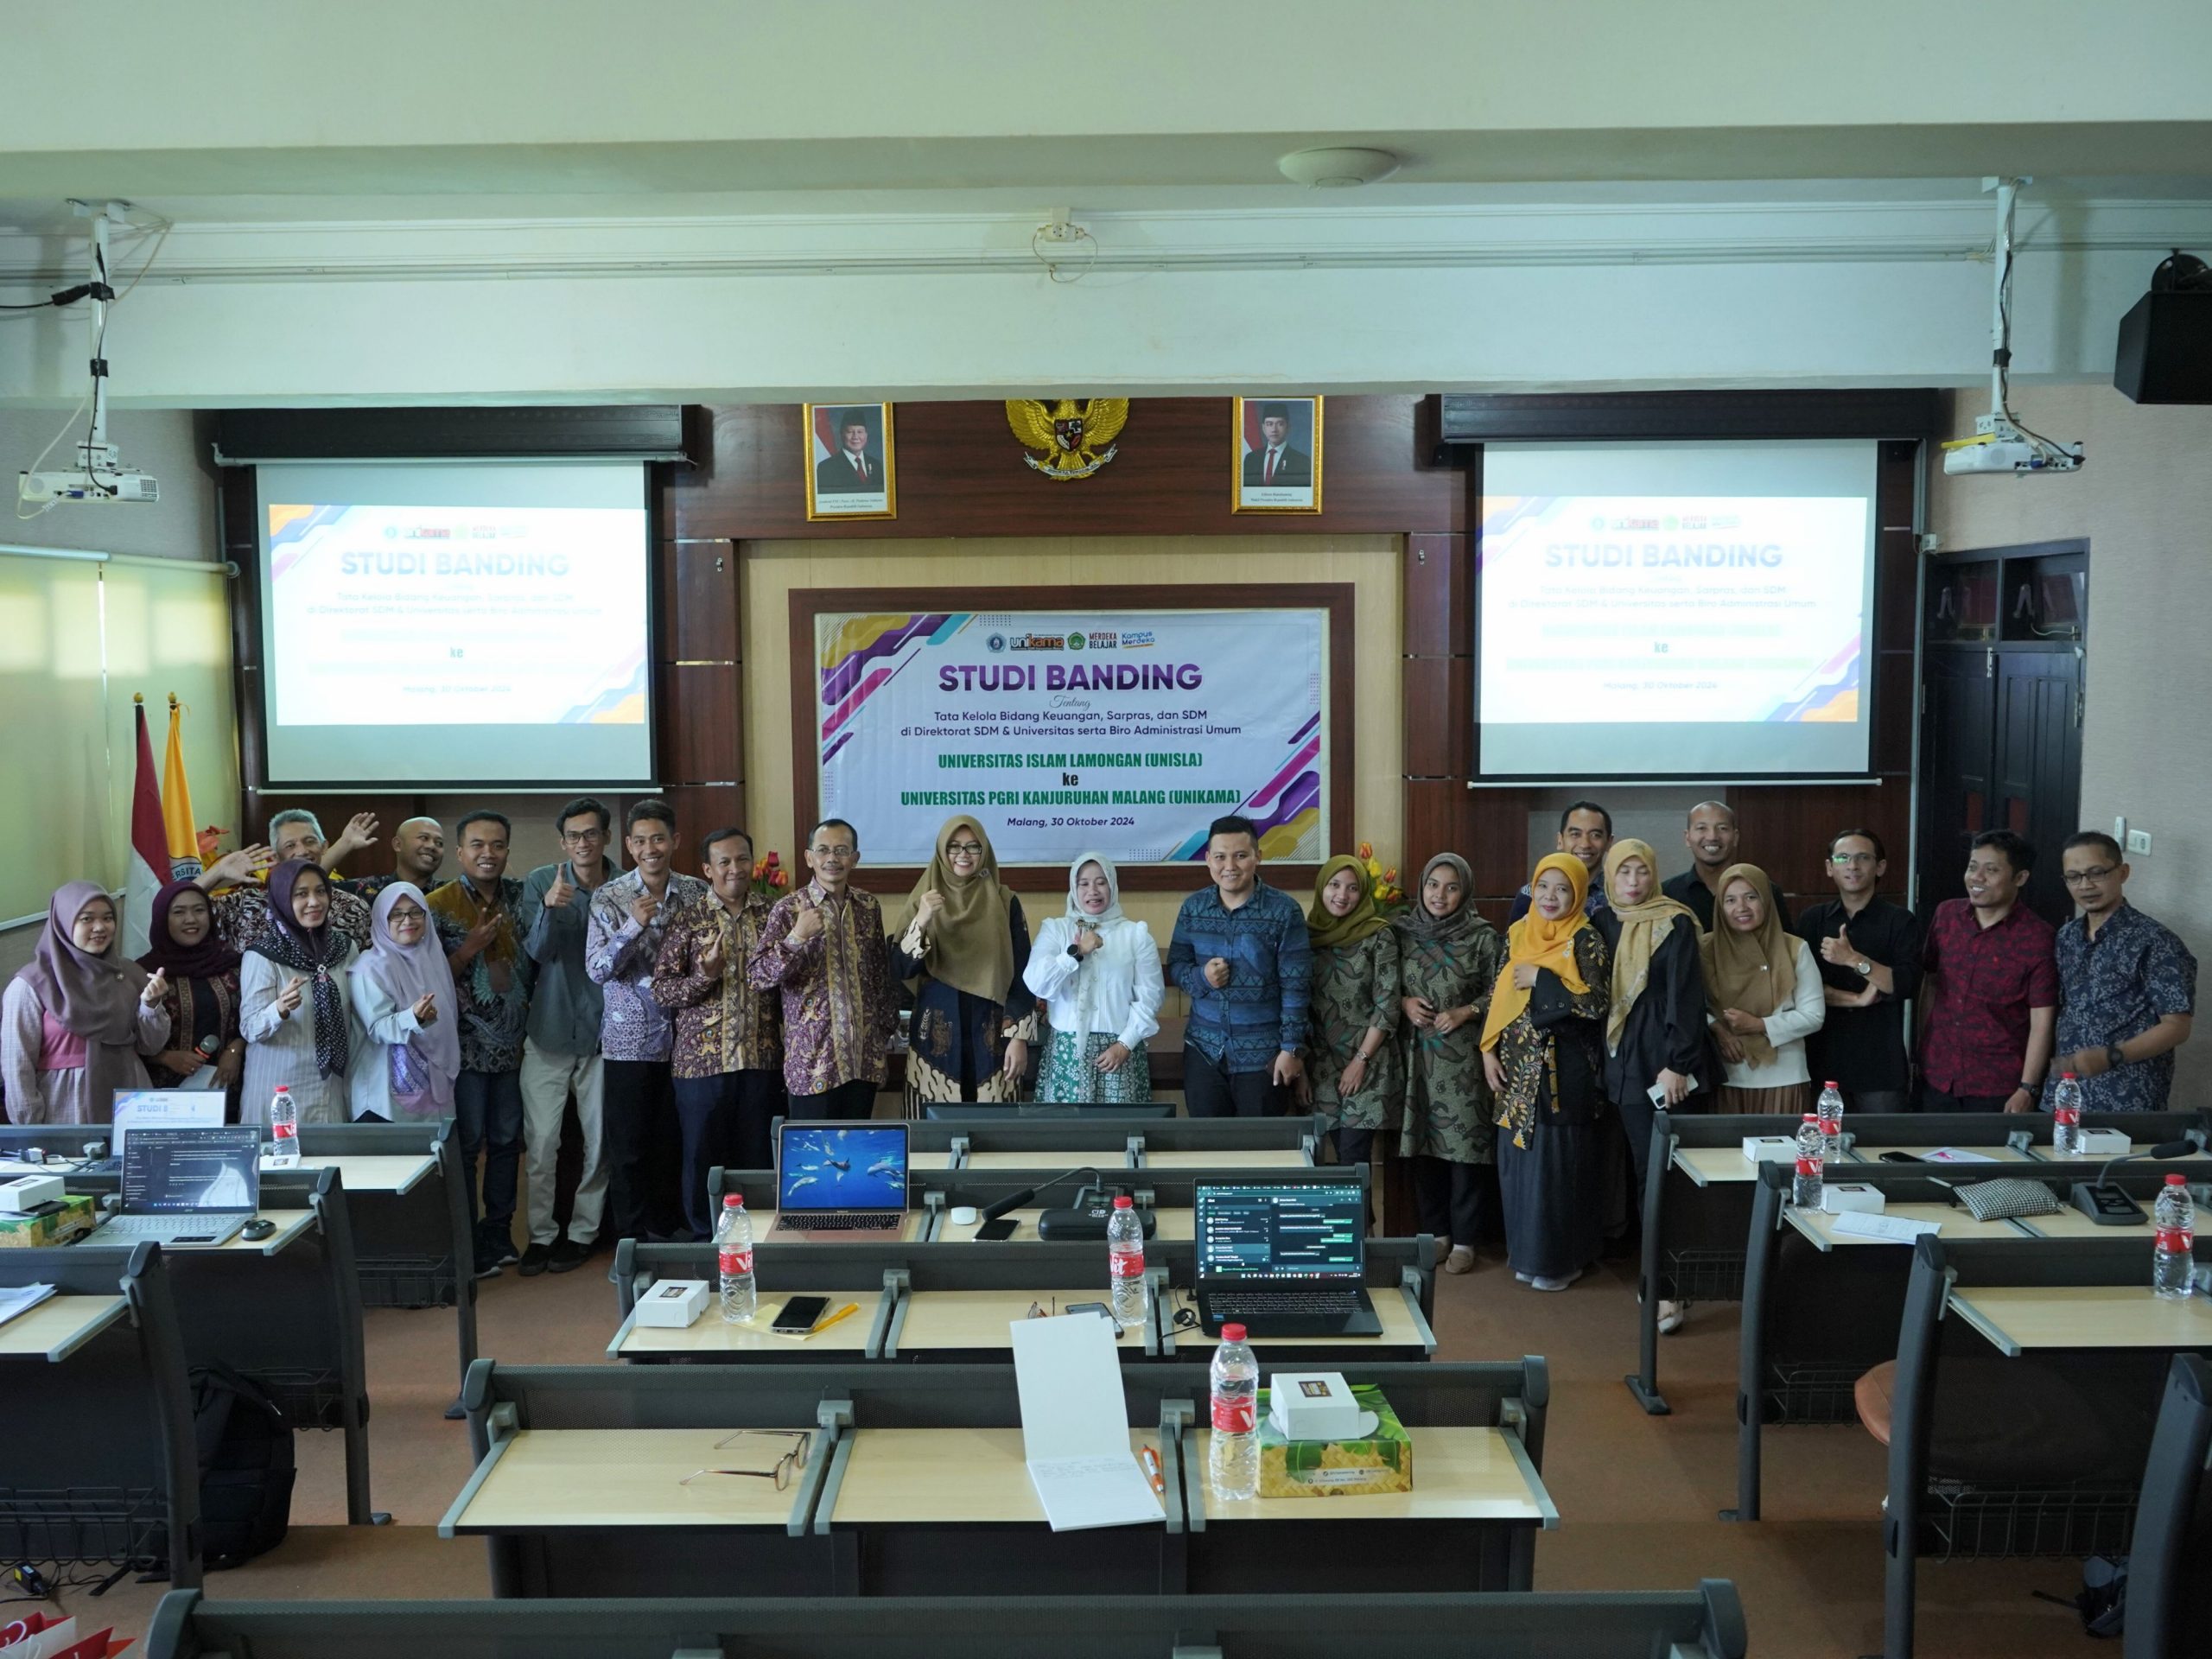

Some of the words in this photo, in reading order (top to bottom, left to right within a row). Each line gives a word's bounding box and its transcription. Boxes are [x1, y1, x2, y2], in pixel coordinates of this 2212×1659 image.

[1545, 543, 1632, 568] STUDI
[1642, 543, 1784, 568] BANDING
[340, 551, 426, 575] STUDI
[435, 552, 570, 576] BANDING
[1122, 631, 1153, 641] Kampus
[1122, 637, 1155, 645] Merdeka
[1089, 640, 1117, 649] BELAJAR
[1654, 641, 1669, 653] ke
[449, 646, 464, 658] ke
[938, 664, 1036, 692] STUDI
[1046, 663, 1203, 691] BANDING
[1048, 695, 1091, 712] Tentang
[934, 711, 960, 722] Tata
[962, 711, 997, 722] Kelola
[1000, 711, 1040, 723] Bidang
[1042, 710, 1103, 723] Keuangan,
[1107, 710, 1154, 722] Sarpras,
[1156, 710, 1179, 720] dan
[1181, 709, 1208, 720] SDM
[900, 727, 912, 737] di
[914, 726, 971, 736] Direktorat
[974, 726, 1000, 736] SDM
[1002, 726, 1011, 736] &
[1014, 726, 1075, 735] Universitas
[1077, 726, 1107, 735] serta
[1109, 725, 1131, 735] Biro
[1134, 724, 1204, 735] Administrasi
[1205, 725, 1242, 734] Umum
[938, 753, 1024, 769] UNIVERSITAS
[1026, 753, 1067, 768] ISLAM
[1070, 753, 1142, 768] LAMONGAN
[1145, 753, 1203, 767] (UNISLA)
[1062, 772, 1079, 786] ke
[900, 791, 986, 806] UNIVERSITAS
[988, 791, 1020, 805] PGRI
[1023, 791, 1109, 805] KANJURUHAN
[1111, 790, 1166, 805] MALANG
[1169, 790, 1241, 804] (UNIKAMA)
[1007, 817, 1049, 829] Malang,
[1051, 817, 1064, 827] 30
[1065, 817, 1109, 827] Oktober
[1109, 817, 1135, 827] 2024
[137, 1104, 162, 1113] STUDI
